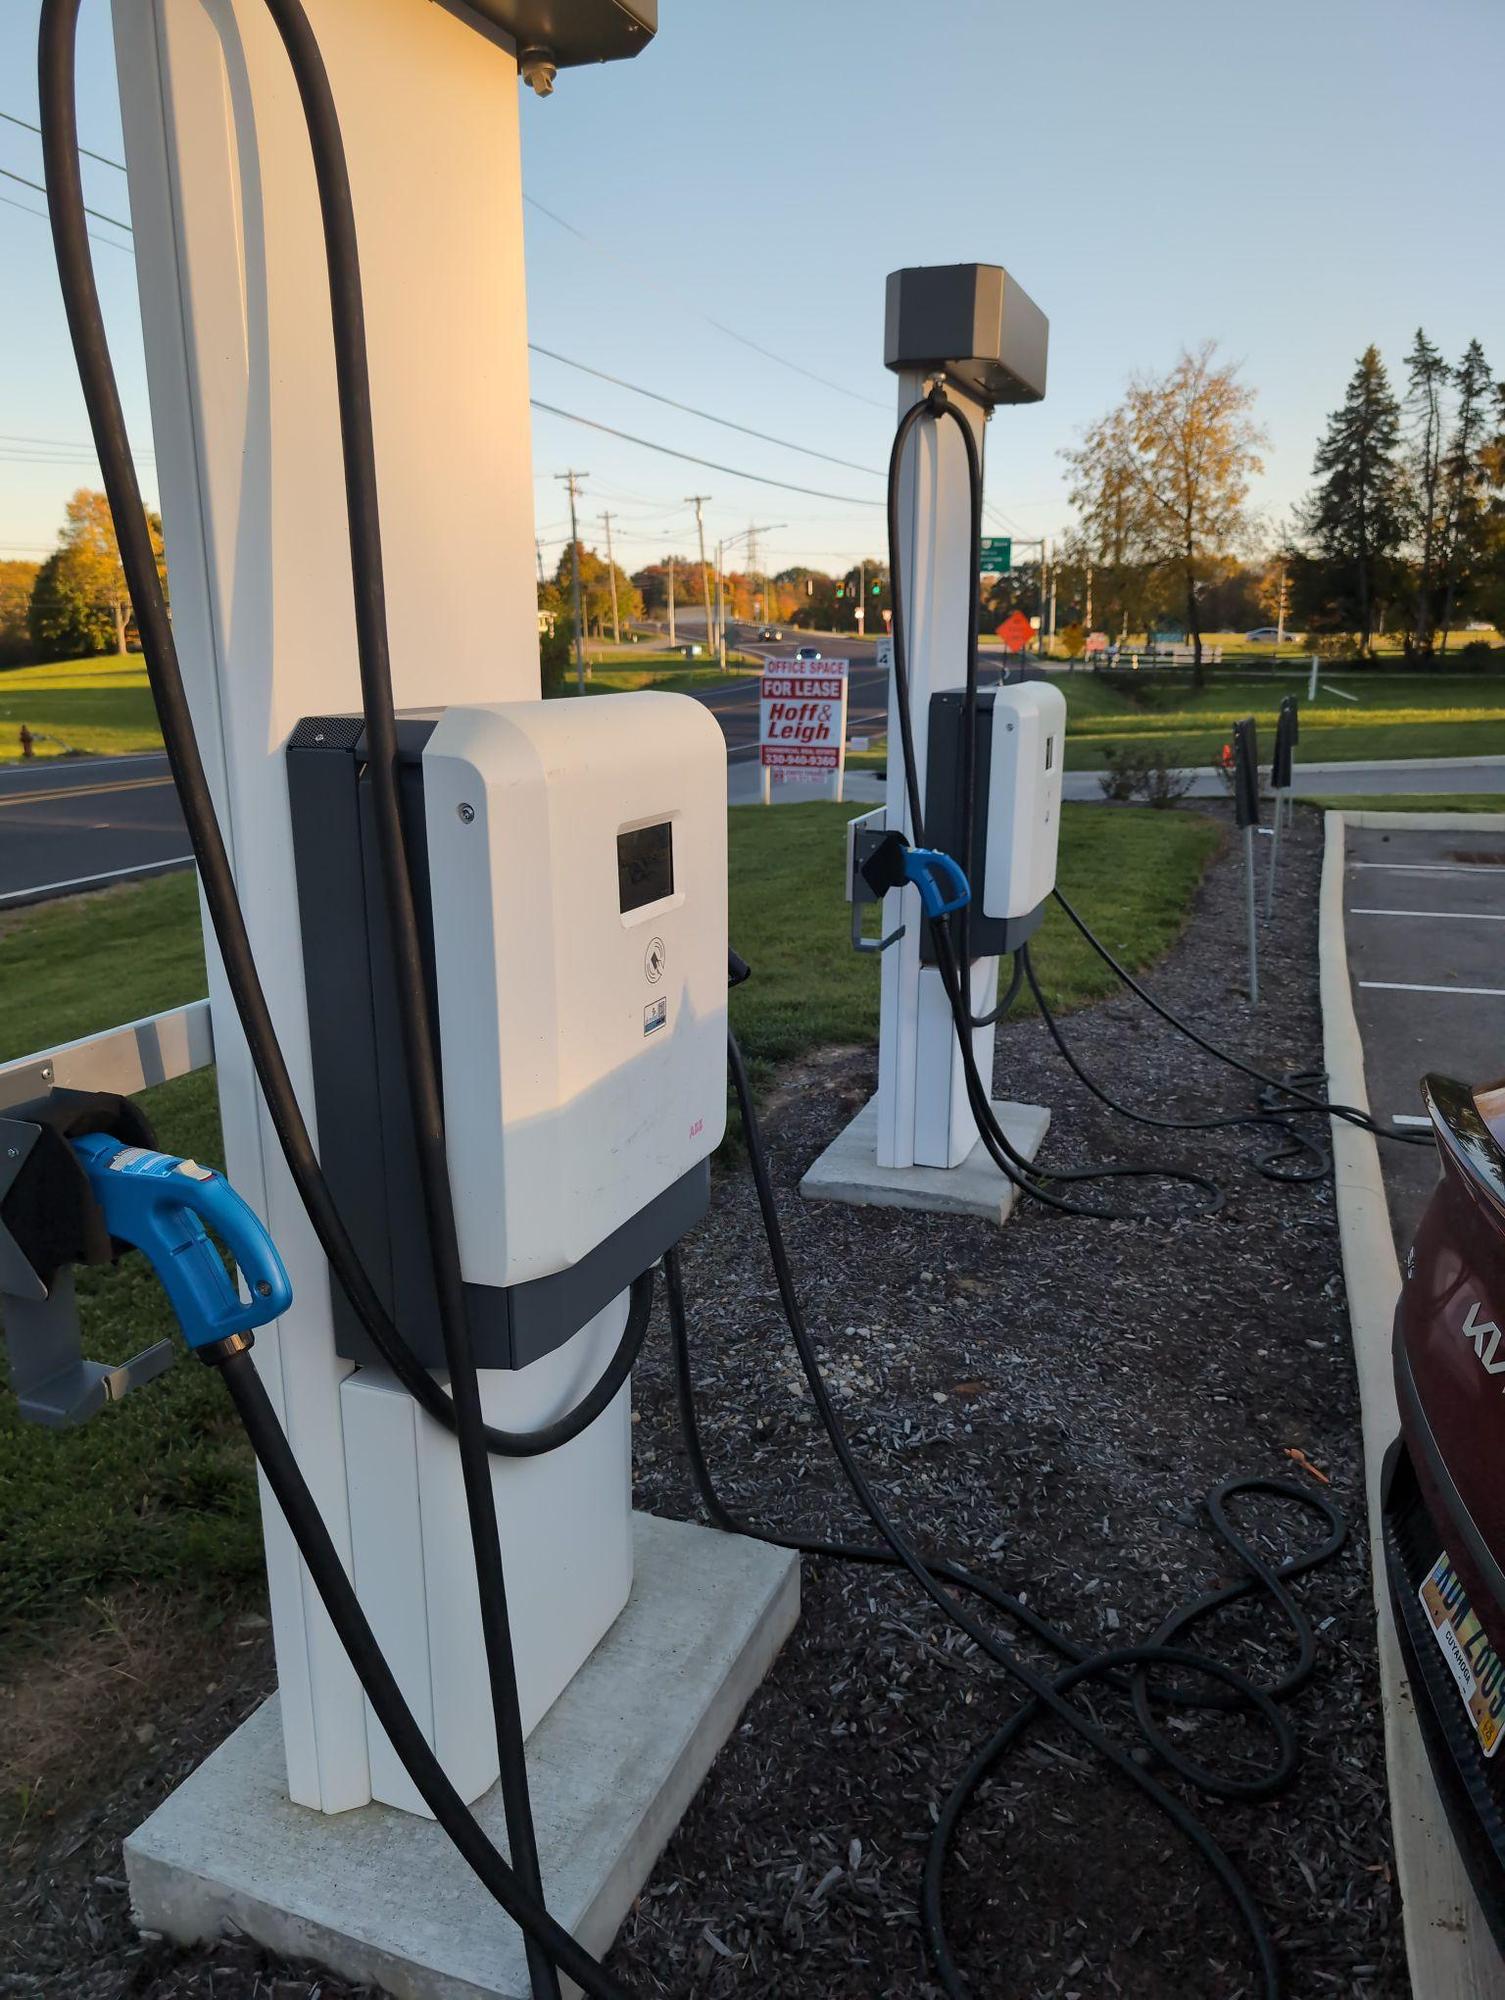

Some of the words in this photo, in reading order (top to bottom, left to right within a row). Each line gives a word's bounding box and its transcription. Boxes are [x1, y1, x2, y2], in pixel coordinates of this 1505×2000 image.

[768, 661, 806, 674] OFFICE
[810, 661, 844, 674] SPACE
[764, 681, 792, 696] FOR
[796, 681, 840, 697] LEASE
[768, 721, 830, 743] Leigh
[1445, 1630, 1470, 1685] CUYAHOGA
